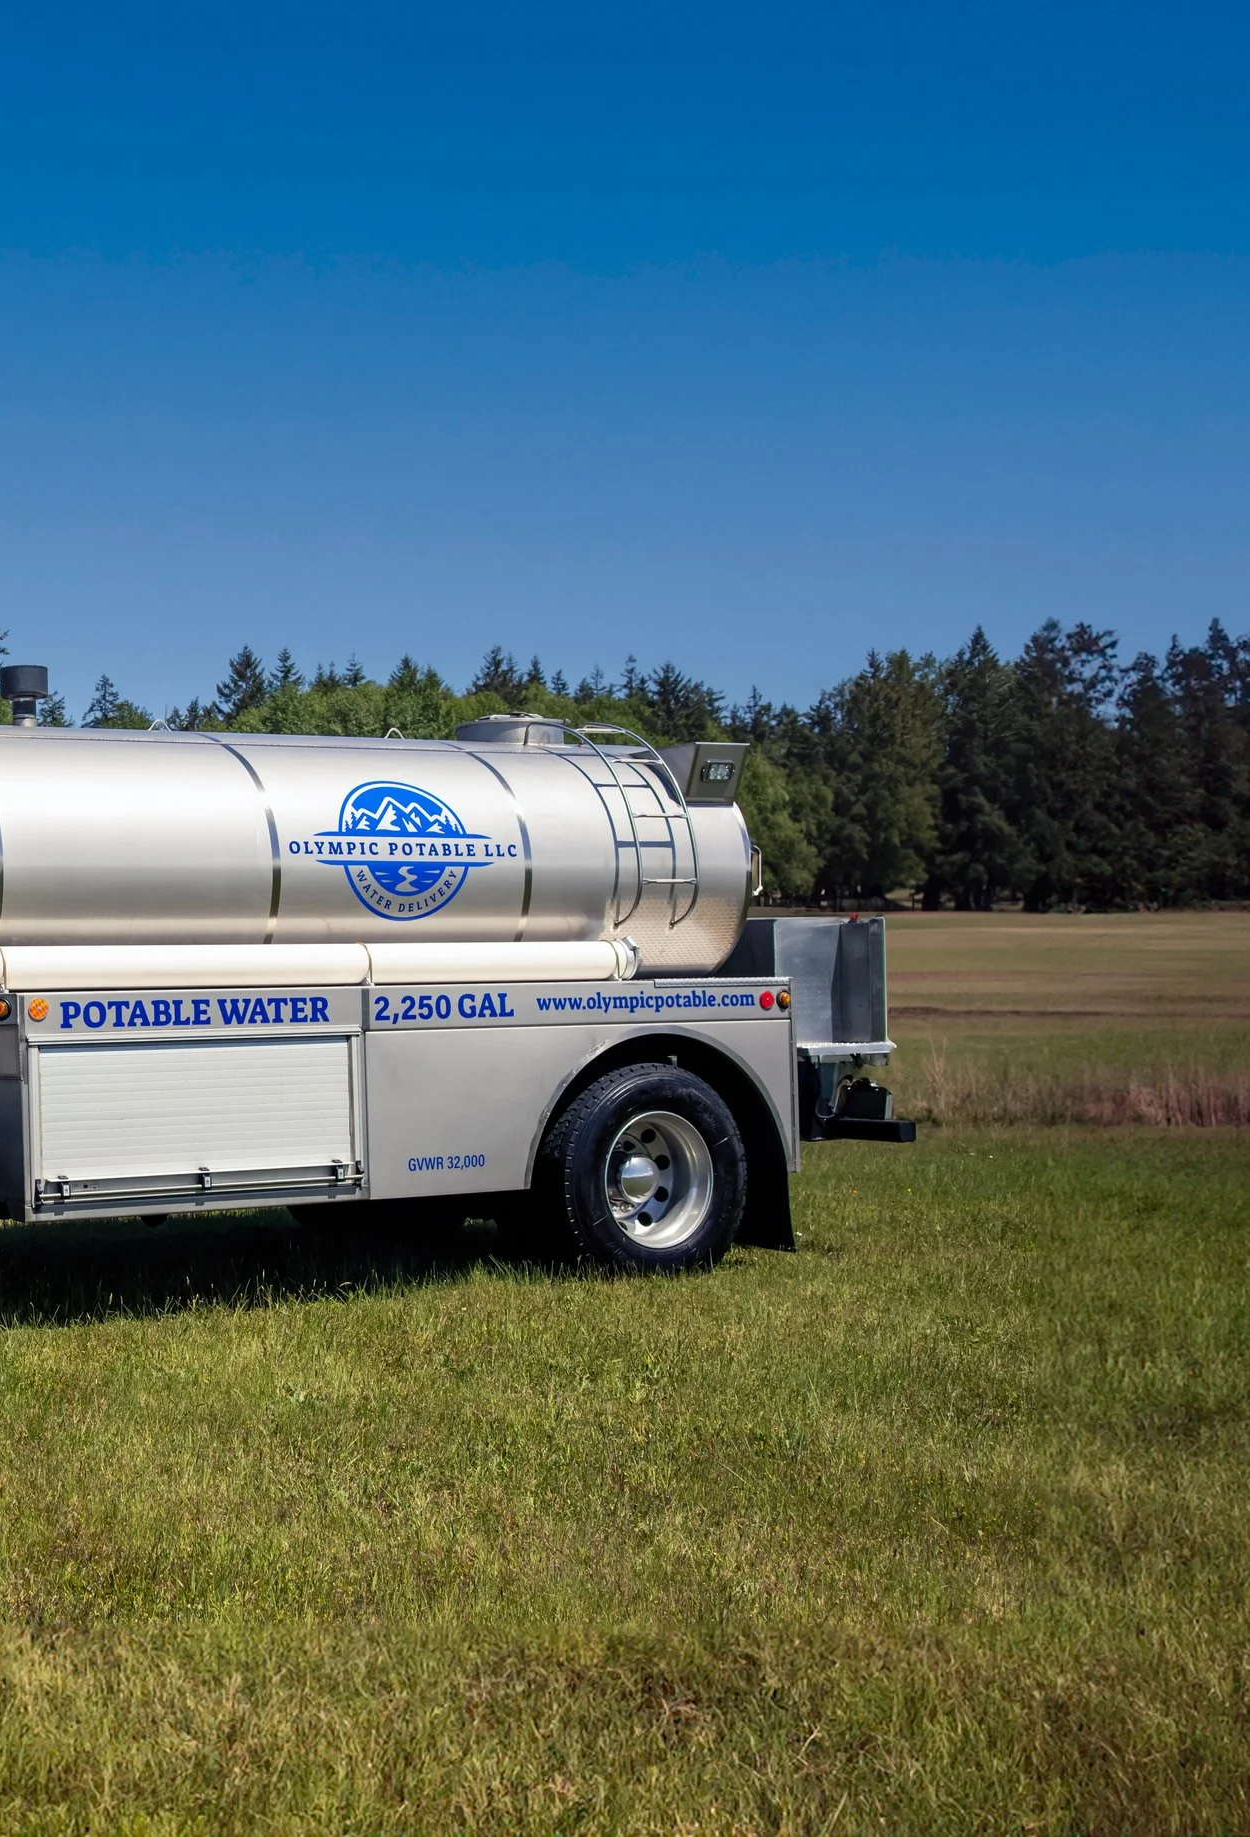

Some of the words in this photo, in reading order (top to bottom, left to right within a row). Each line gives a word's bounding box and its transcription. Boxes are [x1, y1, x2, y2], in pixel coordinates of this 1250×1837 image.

[288, 841, 379, 855] OLYMPIC
[388, 842, 476, 856] POTABLE
[485, 844, 517, 857] LLC
[356, 869, 392, 910] WATER
[398, 870, 457, 912] DELIVERY
[60, 999, 211, 1028] POTABLE
[217, 996, 330, 1025] WATER
[374, 995, 451, 1024] 2,250
[457, 993, 515, 1018] GAL
[536, 990, 756, 1014] www.olympicpotable.com
[408, 1156, 444, 1171] GVWR
[447, 1154, 485, 1170] 32,000
